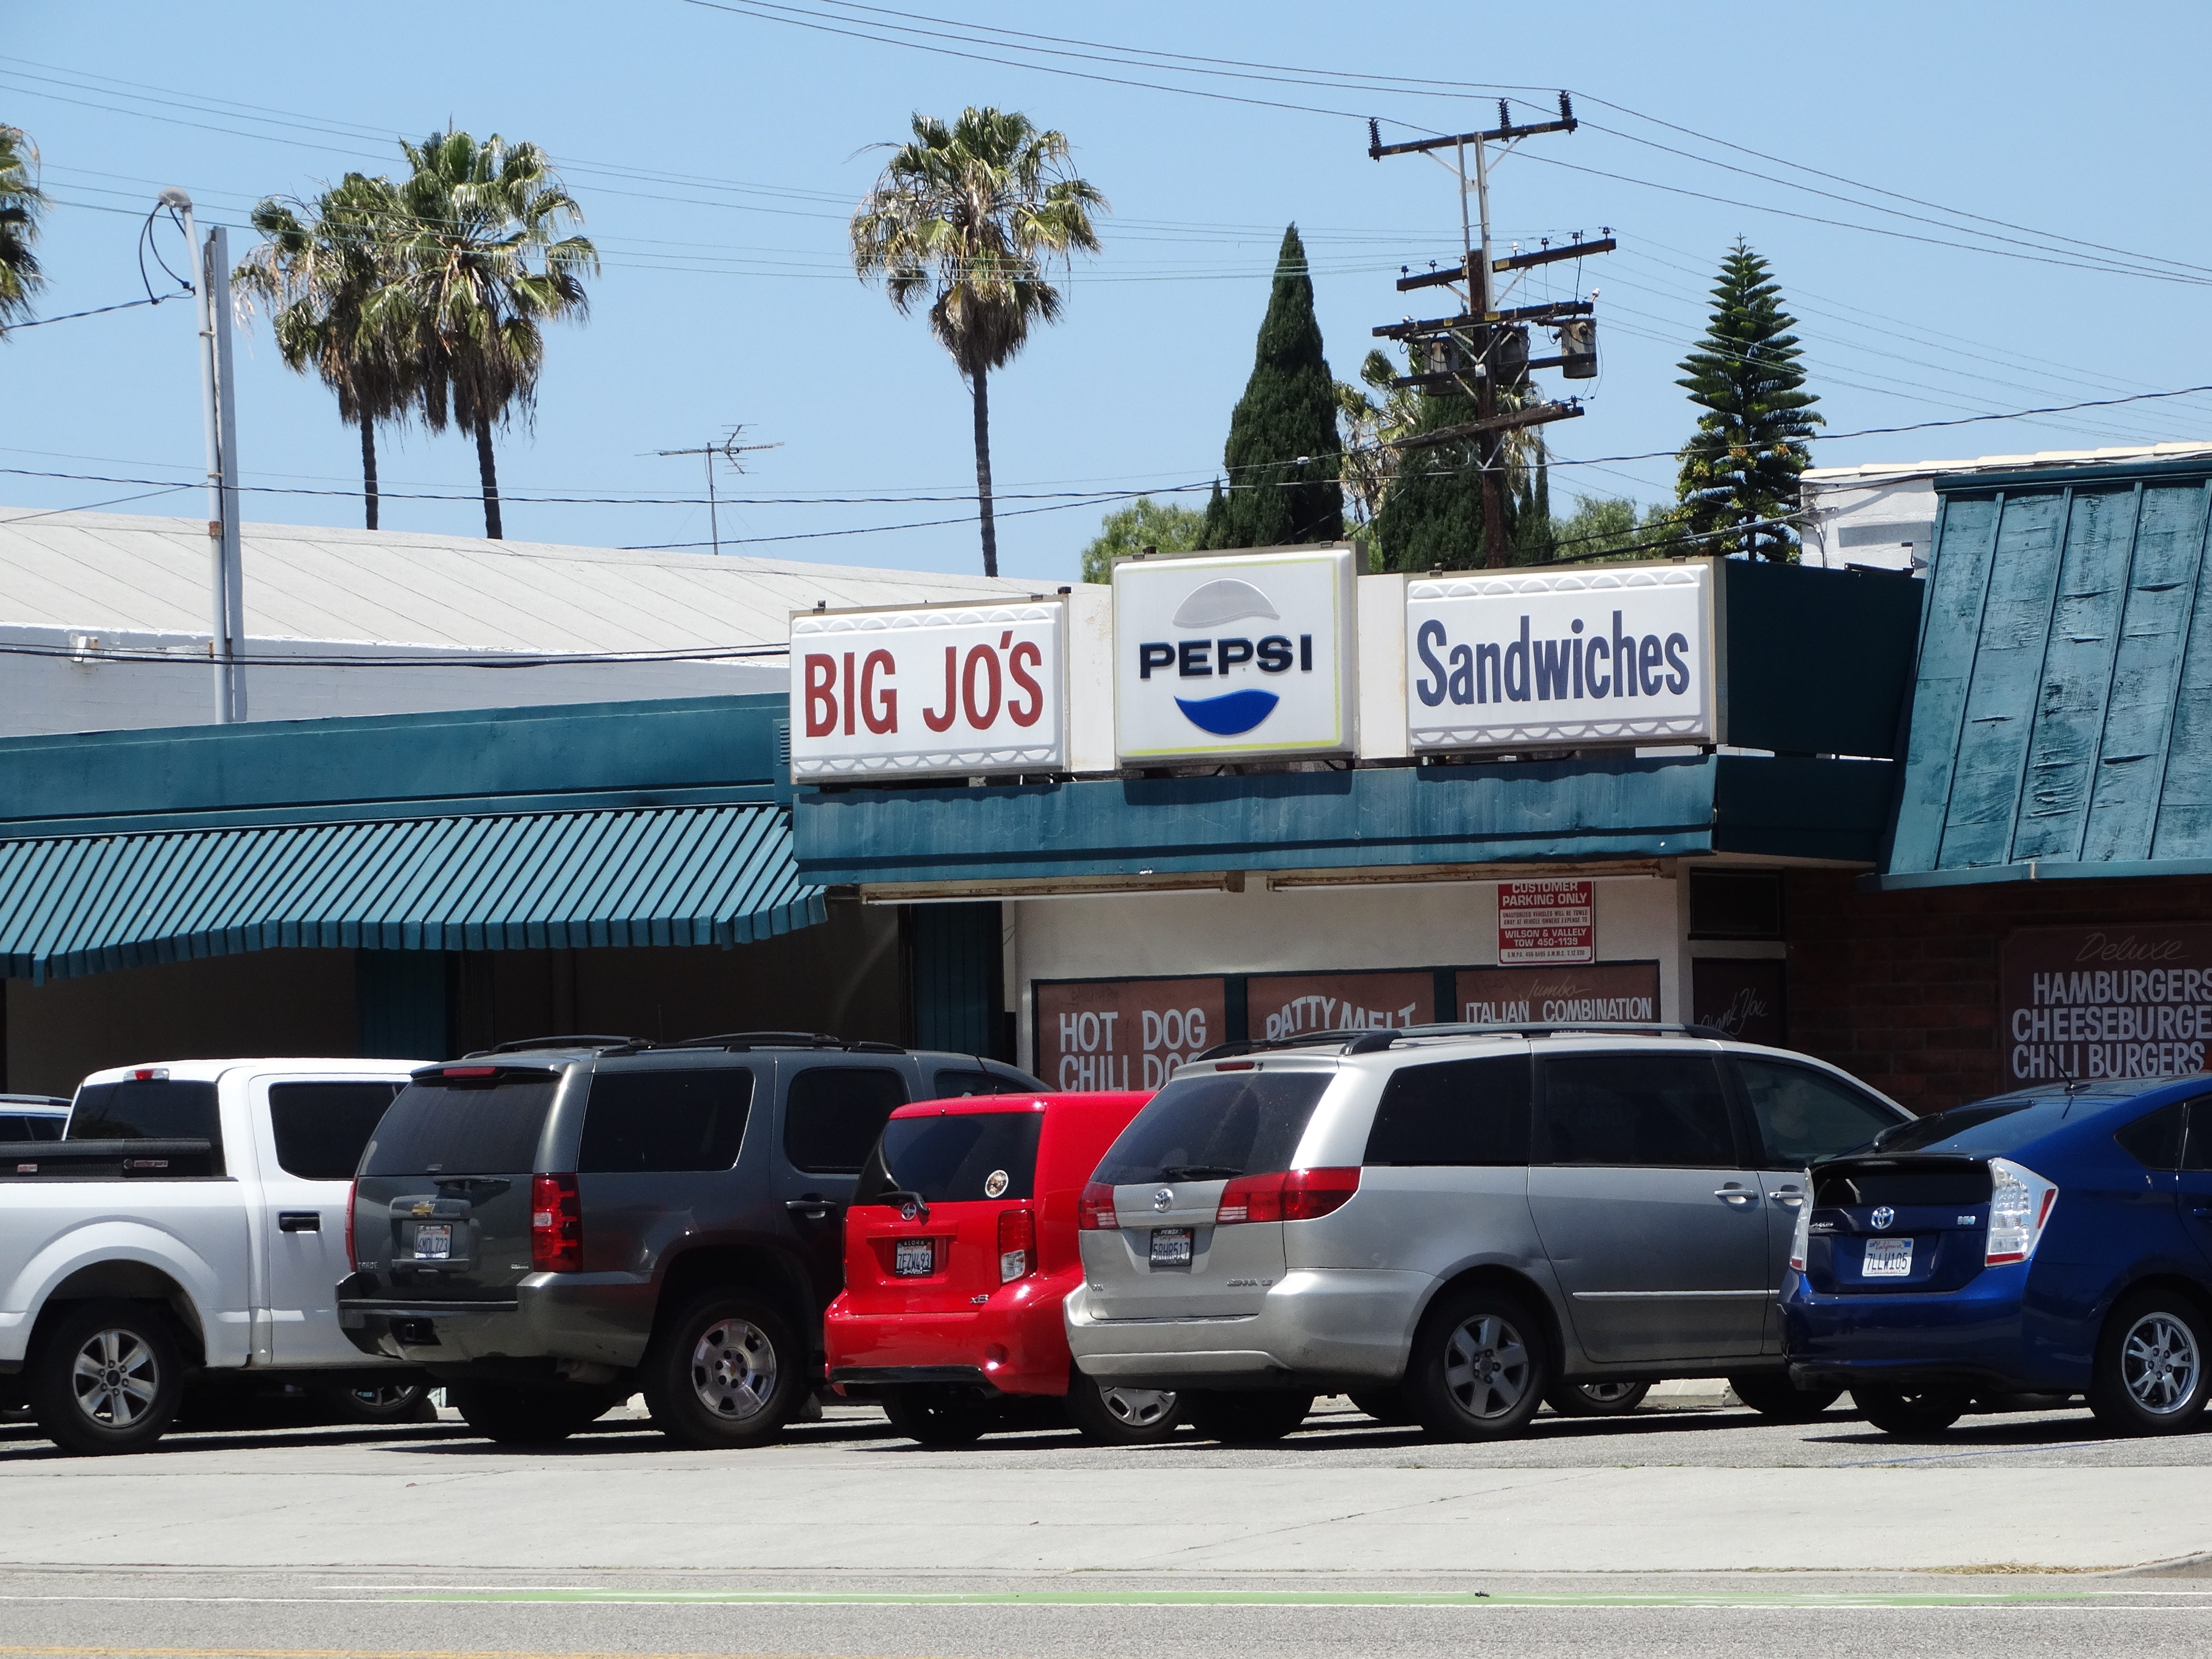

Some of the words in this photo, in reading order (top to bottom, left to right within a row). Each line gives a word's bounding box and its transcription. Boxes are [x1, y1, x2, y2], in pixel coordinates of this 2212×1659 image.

[1139, 634, 1312, 678] PEPSI
[1417, 610, 1690, 707] Sandwiches
[805, 648, 898, 738] BIG
[923, 630, 1044, 733] JO'S
[1503, 894, 1554, 906] PARKING
[1558, 893, 1587, 905] ONLY
[1512, 882, 1578, 893] CUSTOMER
[1505, 929, 1540, 938] WILSON
[1552, 928, 1587, 937] VALLELY
[1537, 937, 1578, 946] 450-1139
[2075, 932, 2191, 962] Deluxe
[2033, 967, 2212, 1005] HAMBURGERS
[1266, 995, 1336, 1041] PATTY
[1465, 1001, 1530, 1023] ITALIAN
[1543, 997, 1652, 1022] COMBINATION
[1729, 987, 1768, 1035] You
[1059, 1011, 1118, 1053] HOT
[1142, 1007, 1207, 1051] DOG
[1059, 1054, 1129, 1091] CHILI
[1143, 1052, 1201, 1091] DO
[2012, 1044, 2079, 1079] CHILI
[2089, 1041, 2205, 1078] BURGERS
[1867, 1252, 1907, 1270] 7LLW105
